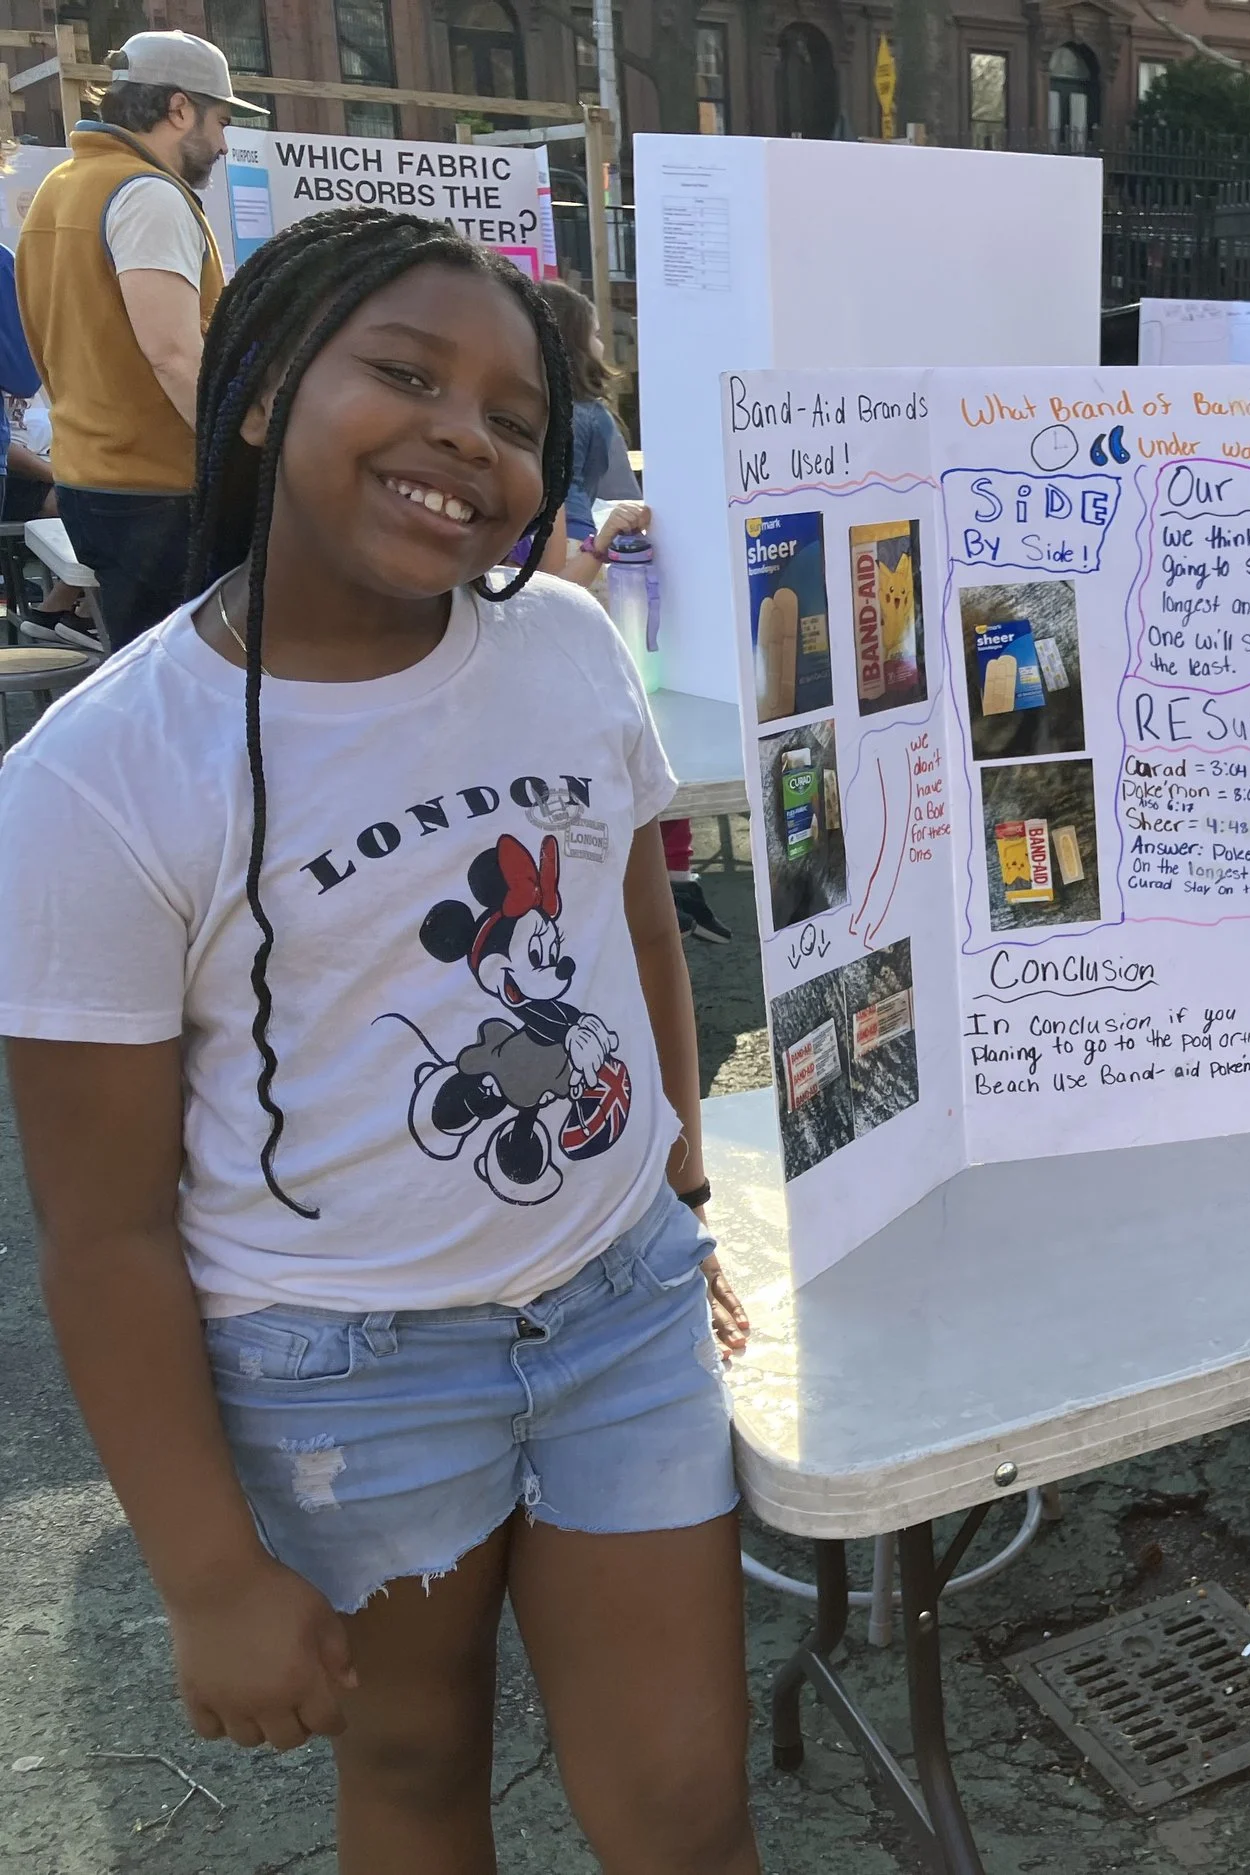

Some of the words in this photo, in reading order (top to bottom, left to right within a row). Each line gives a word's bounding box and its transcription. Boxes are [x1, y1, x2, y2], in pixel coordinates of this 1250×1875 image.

[275, 142, 383, 173] WHICH
[397, 151, 512, 181] FABRIC
[293, 176, 436, 207] ABSORBS
[442, 186, 502, 209] THE
[730, 376, 845, 433] Band-Aid
[858, 392, 928, 423] Brands
[961, 391, 1037, 428] What
[1049, 390, 1134, 422] Brand
[1142, 392, 1172, 417] of
[1167, 465, 1233, 507] Our
[747, 538, 798, 565] sheer
[963, 529, 1000, 560] By
[1211, 556, 1230, 577] to
[857, 553, 881, 683] BAND-AID
[1162, 591, 1221, 627] longest
[977, 632, 1016, 647] sheer
[1195, 628, 1233, 652] will
[1150, 653, 1178, 676] the
[913, 748, 942, 776] don't
[1210, 760, 1248, 778] 3:04
[789, 774, 812, 790] CURAD
[916, 778, 943, 798] have
[1125, 806, 1184, 833] Sheer
[1206, 816, 1249, 834] 4:48
[299, 774, 593, 896] LONDON
[1028, 827, 1049, 885] BAND-AID
[1157, 857, 1180, 876] the
[1188, 860, 1249, 885] longest
[963, 1013, 1010, 1037] In
[1168, 1006, 1190, 1025] if
[1204, 1007, 1237, 1034] you
[1052, 1036, 1074, 1055] to
[1083, 1038, 1107, 1066] go
[1114, 1034, 1136, 1052] to
[1146, 1029, 1174, 1048] the
[974, 1073, 1040, 1096] Beach
